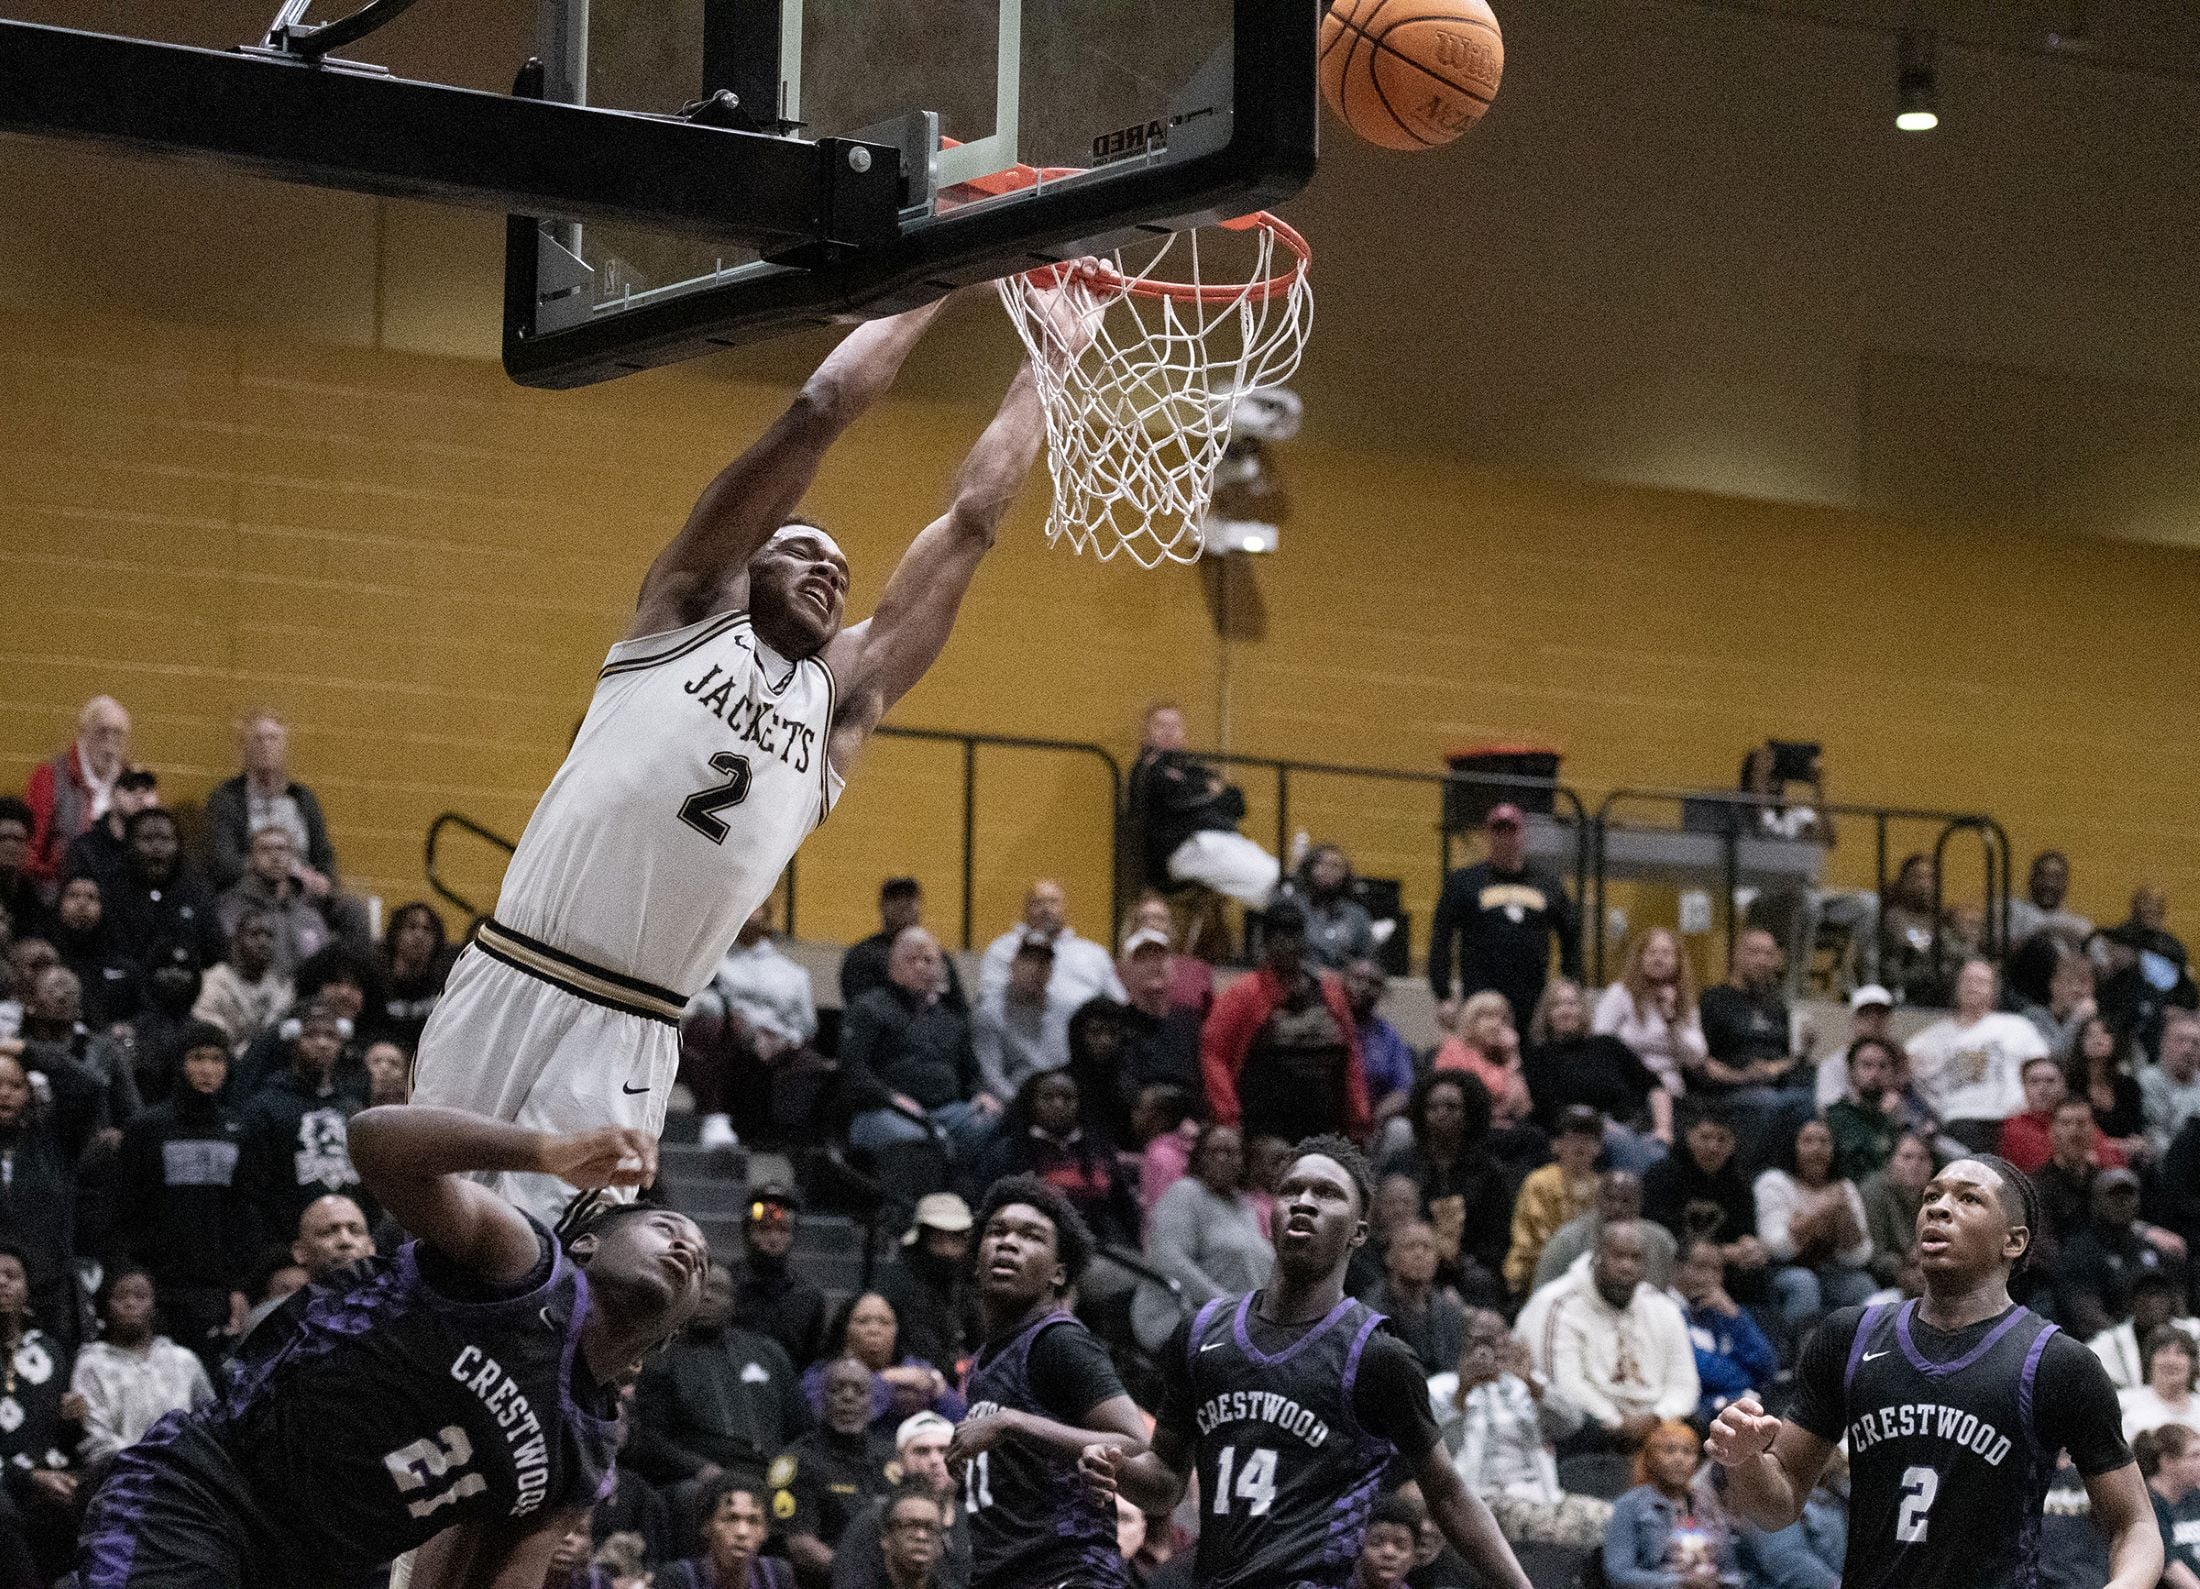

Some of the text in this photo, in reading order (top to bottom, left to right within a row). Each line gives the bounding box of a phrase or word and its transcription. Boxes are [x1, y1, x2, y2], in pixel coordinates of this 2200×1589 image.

[684, 664, 815, 774] JACKETS
[676, 751, 752, 846] 2
[1197, 1391, 1329, 1448] CRESTWOOD
[1851, 1403, 2012, 1467] CRESTWOOD
[384, 1425, 488, 1519] 21
[1213, 1446, 1278, 1516] 14
[1896, 1466, 1939, 1542] 2
